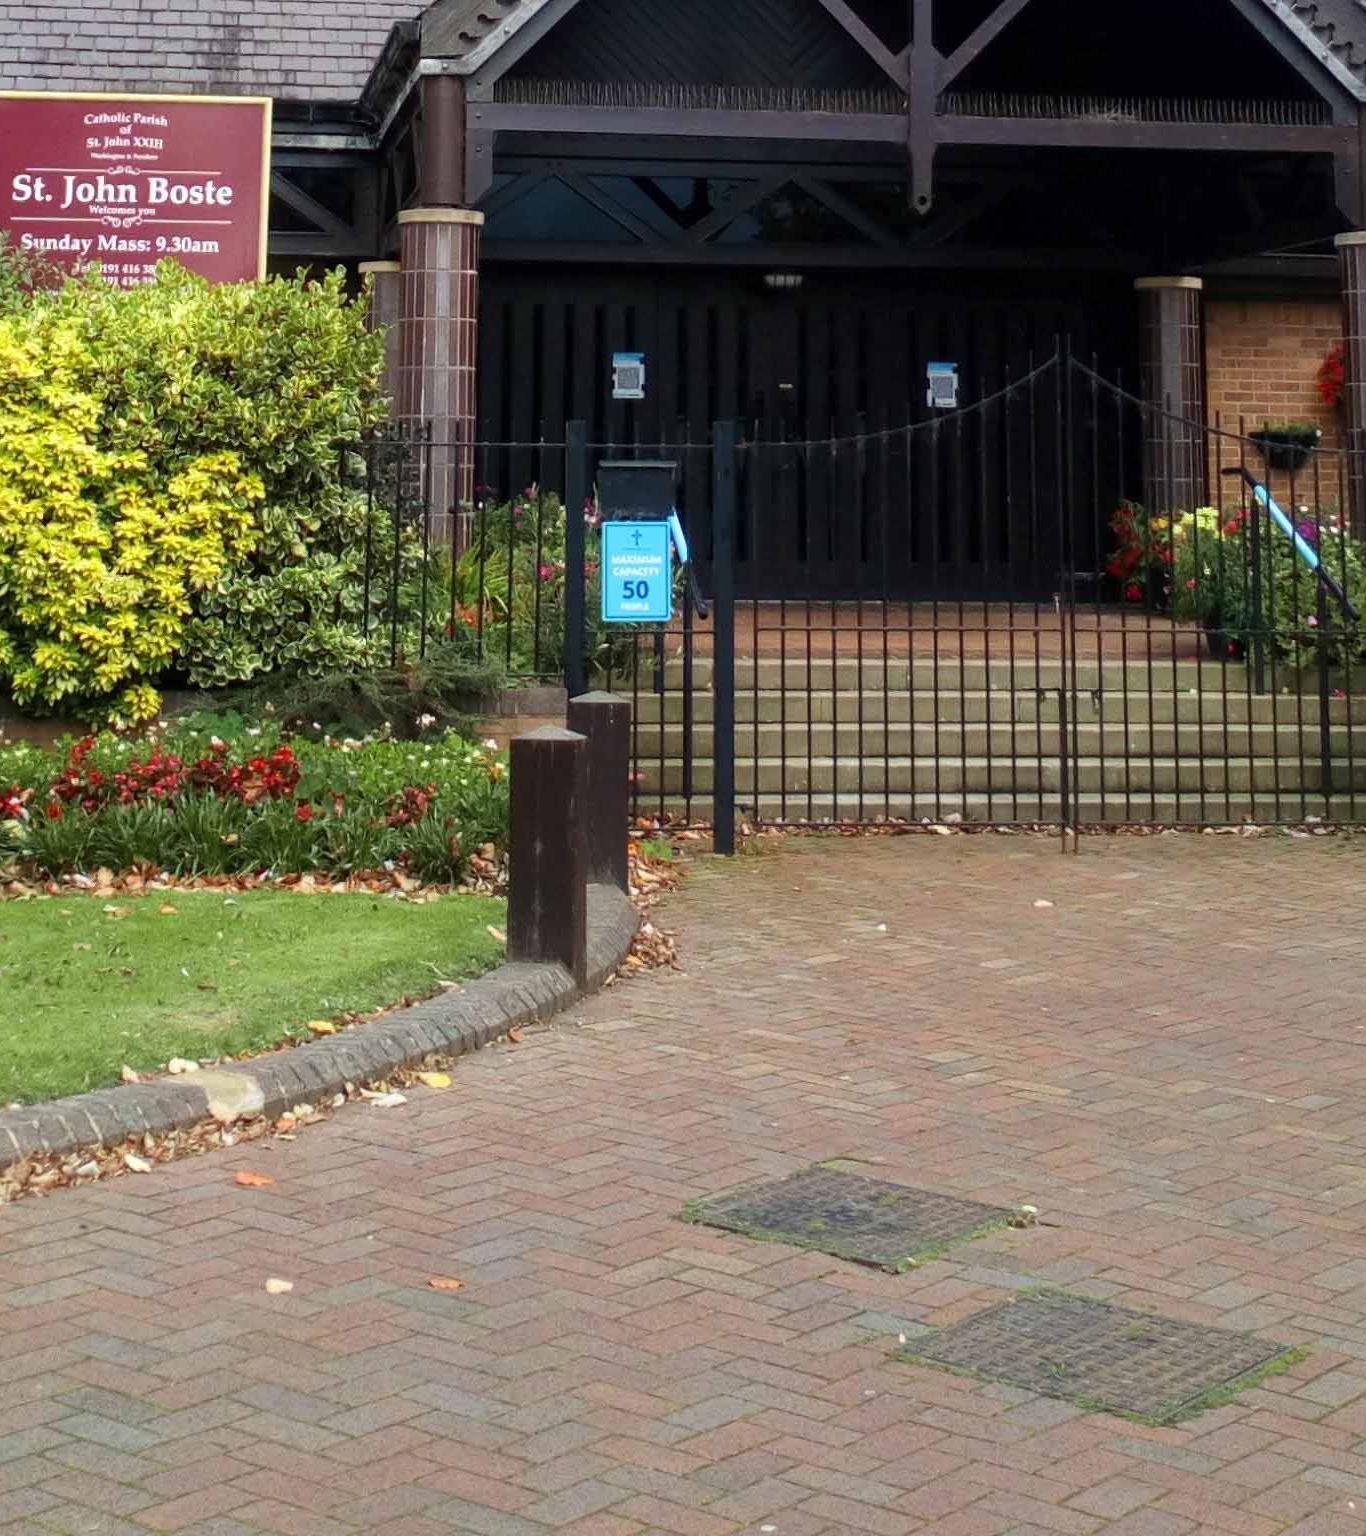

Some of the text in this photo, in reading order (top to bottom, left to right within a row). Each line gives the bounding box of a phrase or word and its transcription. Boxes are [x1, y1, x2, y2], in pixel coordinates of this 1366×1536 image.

[84, 112, 168, 126] Catholic Parish
[119, 124, 132, 135] of
[86, 137, 102, 148] St.
[104, 136, 131, 150] John
[12, 174, 233, 209] St. John Boste
[89, 205, 156, 217] Welcomes you
[21, 233, 219, 256] Sunday Mass: 9.30am
[122, 264, 140, 274] 416
[611, 554, 662, 564] MAXIMUM
[612, 567, 660, 577] CAPACITY
[622, 580, 650, 600] 50
